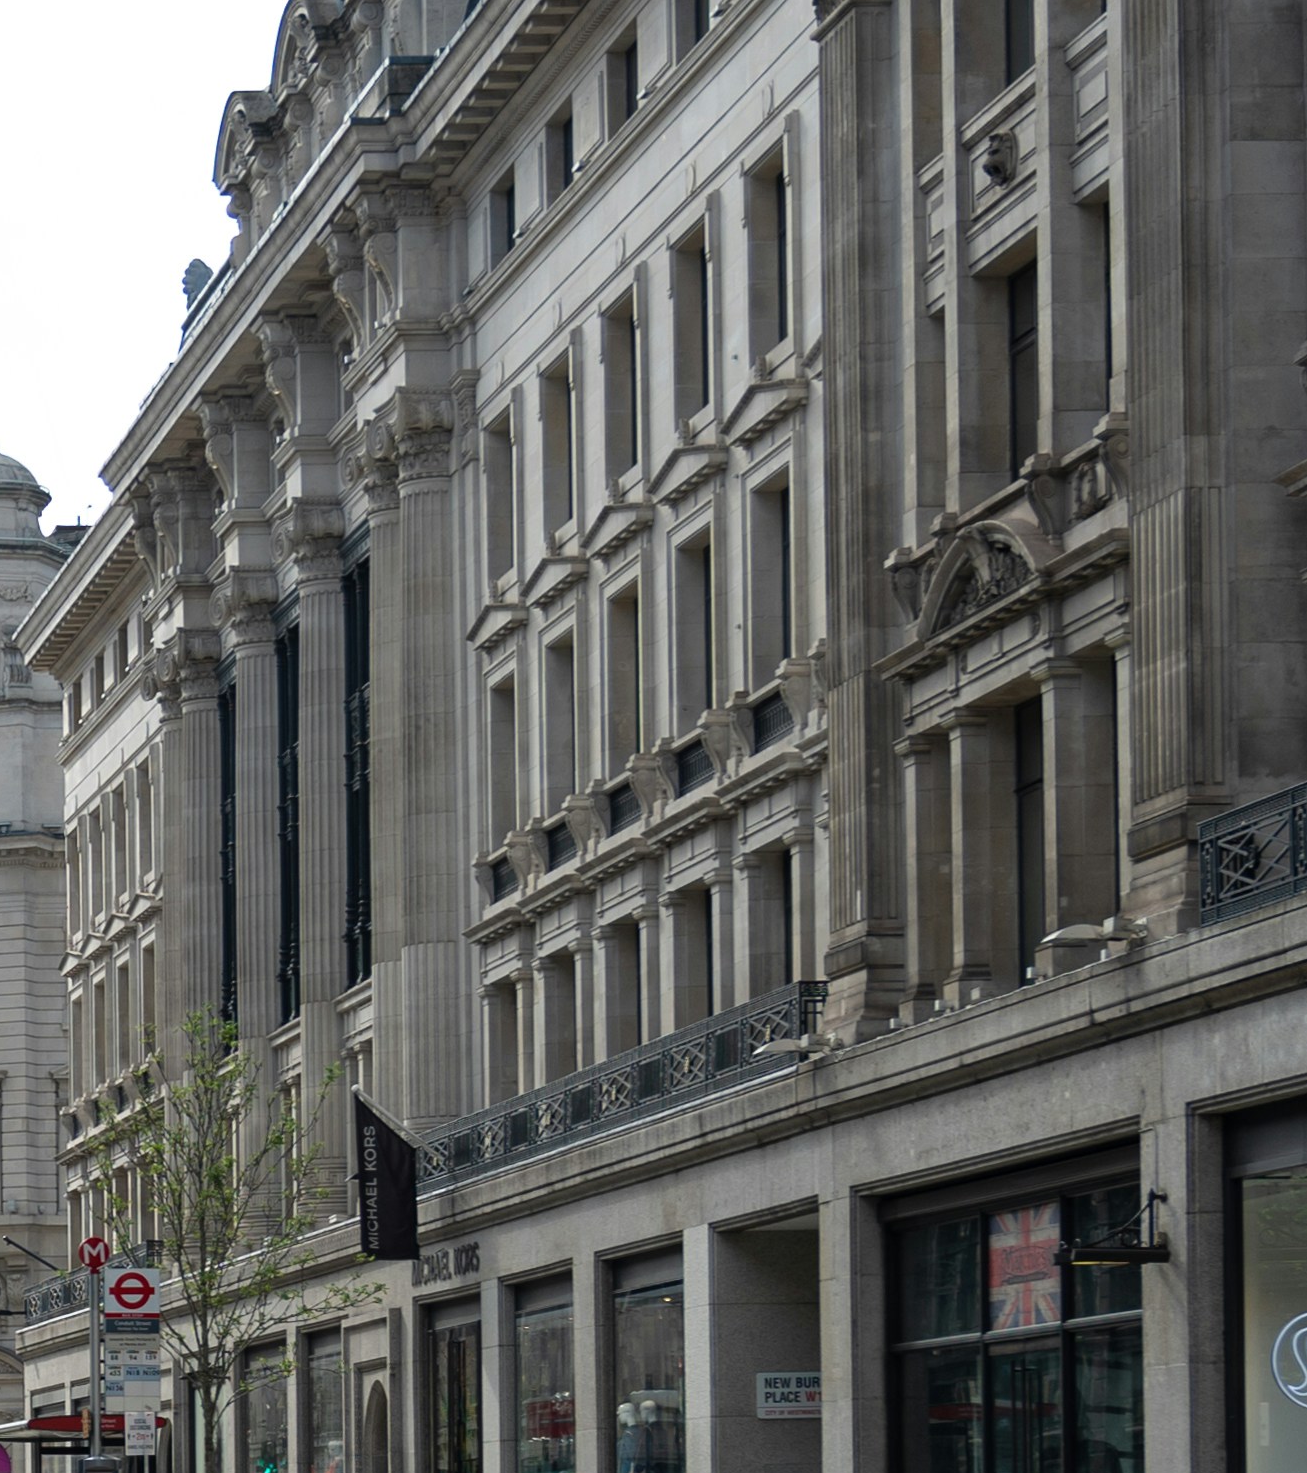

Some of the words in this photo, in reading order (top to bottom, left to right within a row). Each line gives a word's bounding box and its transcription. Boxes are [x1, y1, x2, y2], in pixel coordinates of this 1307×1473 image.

[363, 1126, 377, 1171] KORS
[366, 1178, 379, 1249] MICHAEL
[83, 1242, 105, 1264] M
[412, 1248, 452, 1287] MICHAEL
[454, 1241, 480, 1276] KORS
[764, 1377, 791, 1389] NEW
[795, 1376, 820, 1388] BUR
[764, 1391, 801, 1403] PLACE
[805, 1391, 822, 1403] W1
